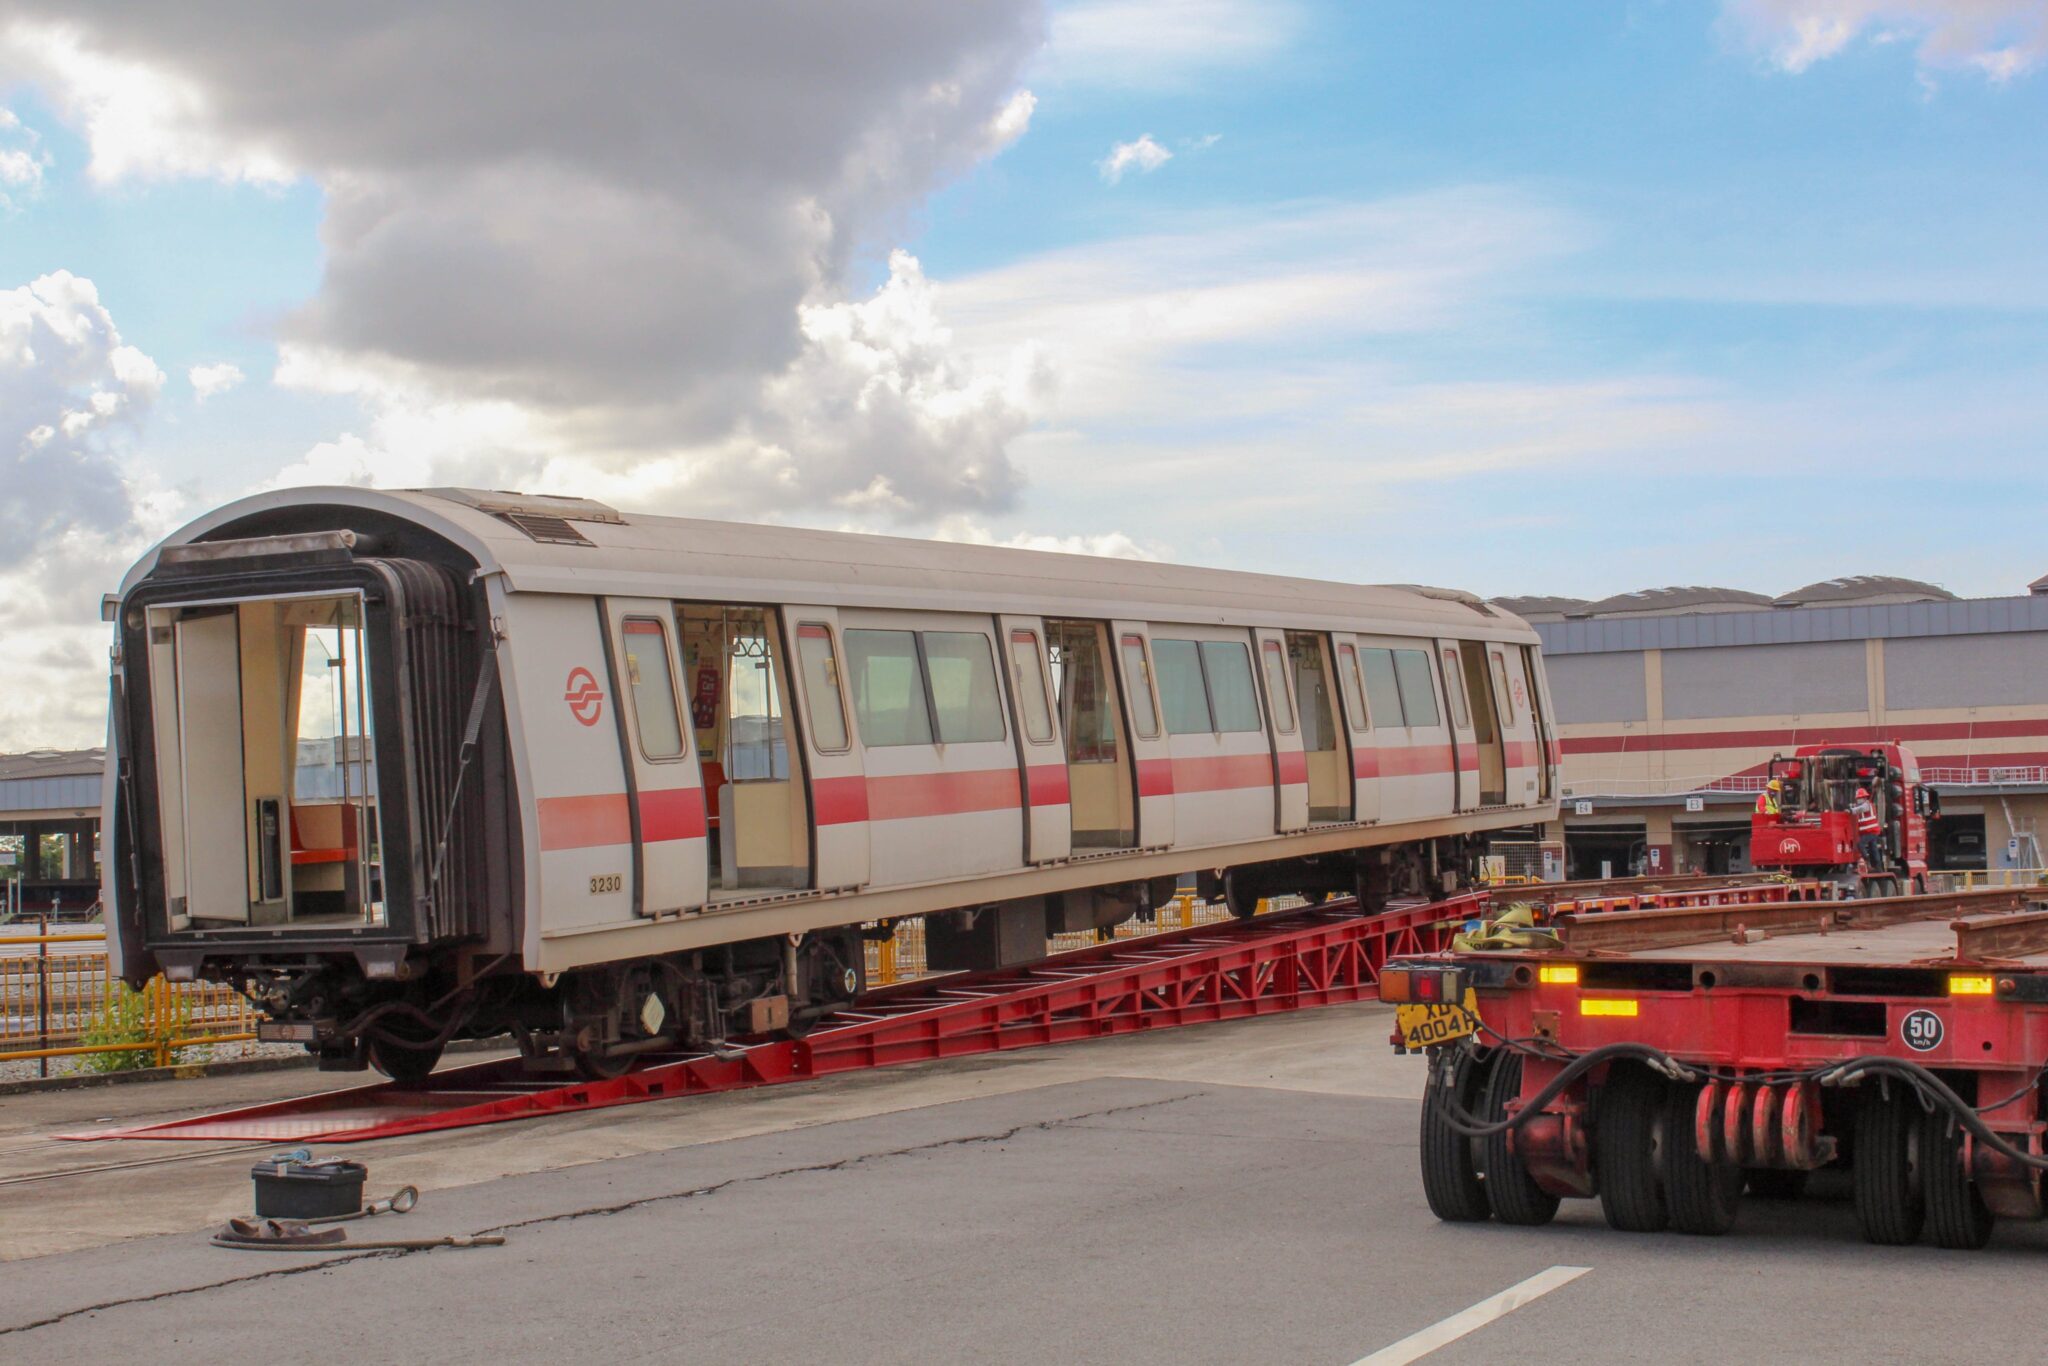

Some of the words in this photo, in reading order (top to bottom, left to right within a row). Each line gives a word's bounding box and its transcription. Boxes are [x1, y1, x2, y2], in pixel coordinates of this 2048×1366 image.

[591, 876, 621, 893] 3230
[1910, 1016, 1936, 1038] 50
[1913, 1038, 1931, 1046] km/h
